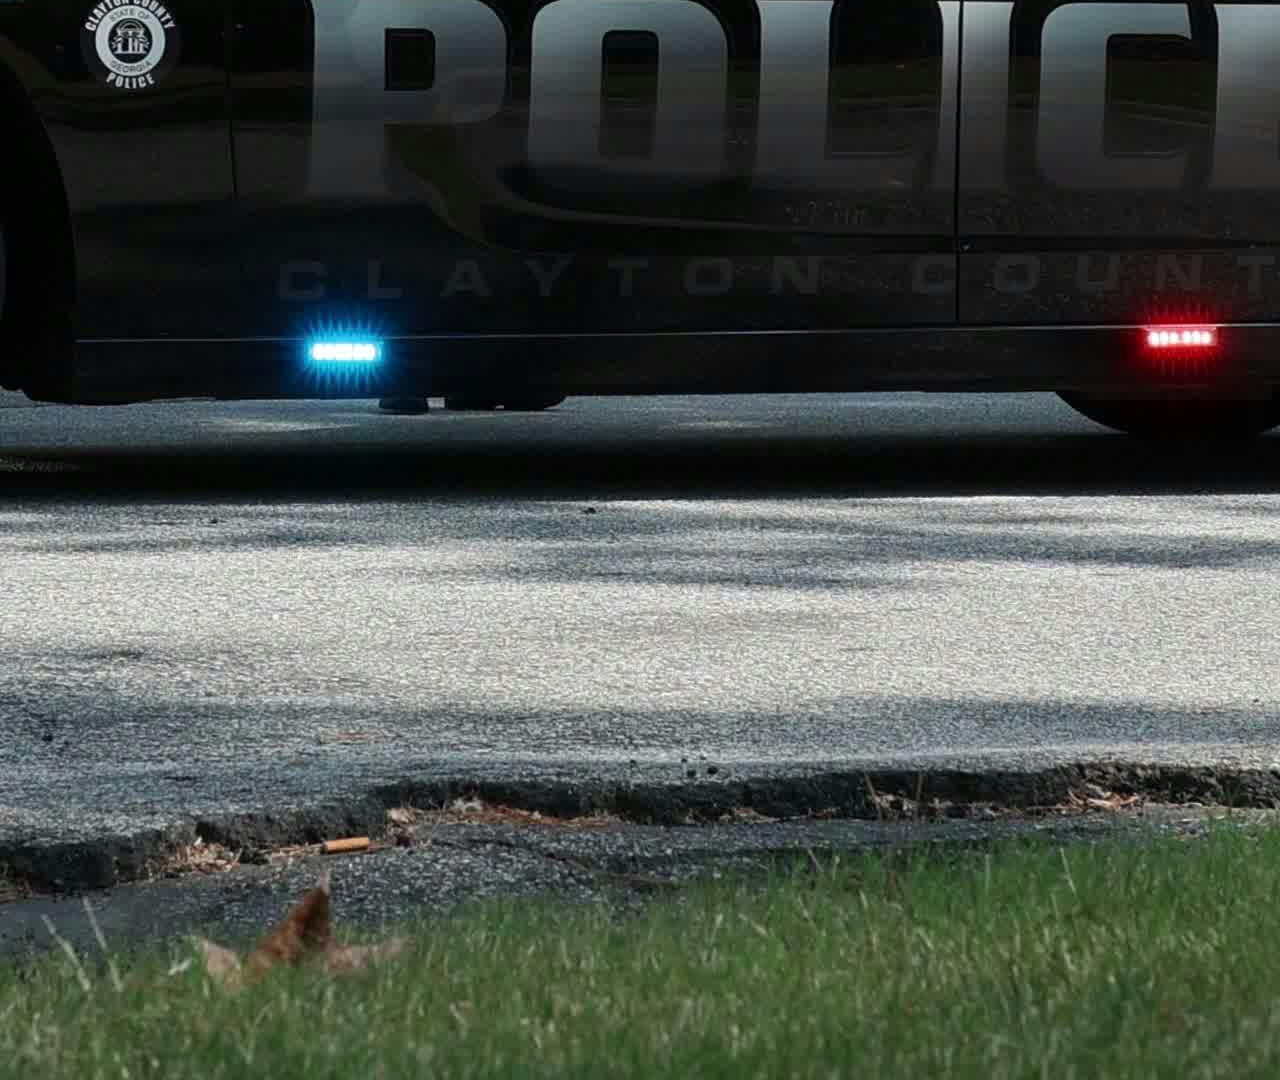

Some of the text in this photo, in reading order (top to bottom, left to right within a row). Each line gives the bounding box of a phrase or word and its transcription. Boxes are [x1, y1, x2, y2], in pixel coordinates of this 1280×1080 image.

[109, 8, 135, 22] STATE
[110, 59, 153, 73] GEORGIA
[106, 72, 155, 89] POLICE
[278, 257, 819, 300] CLAYTON
